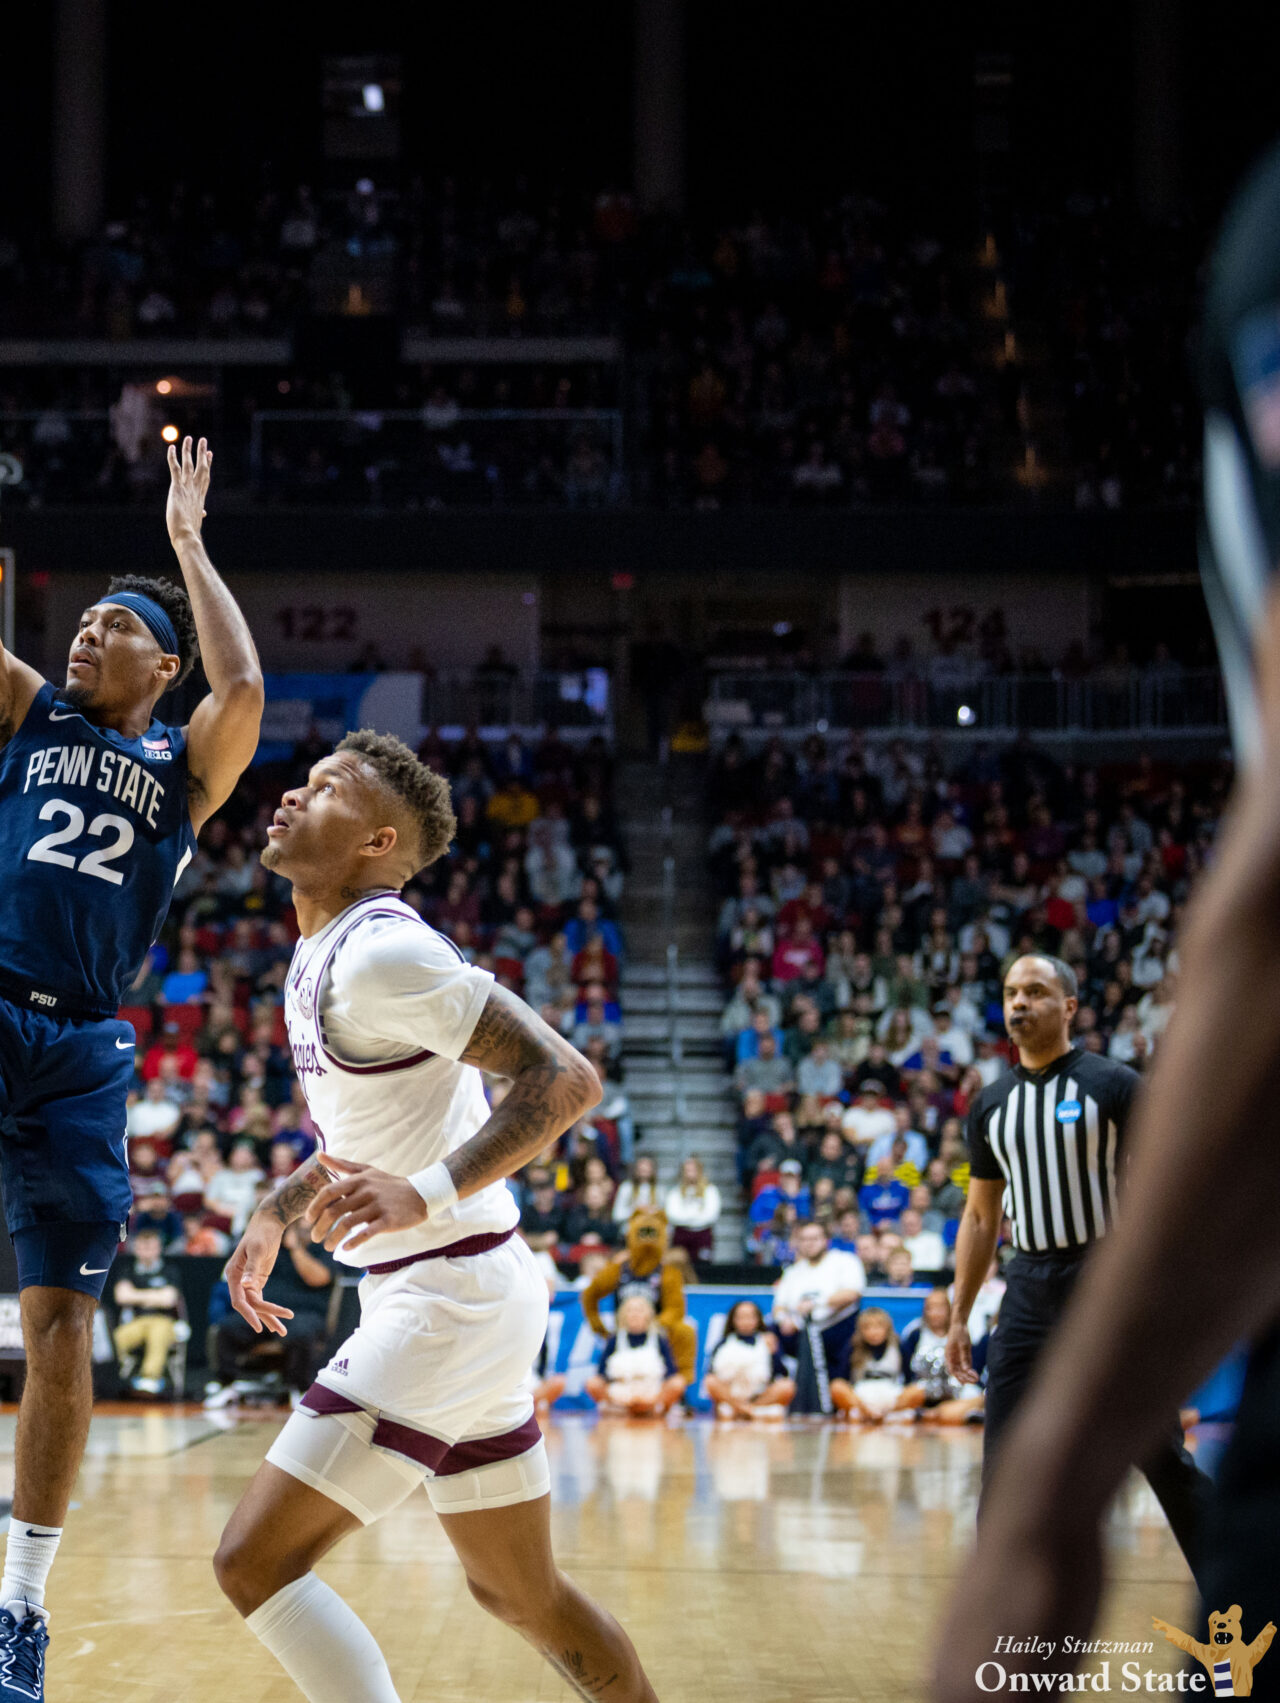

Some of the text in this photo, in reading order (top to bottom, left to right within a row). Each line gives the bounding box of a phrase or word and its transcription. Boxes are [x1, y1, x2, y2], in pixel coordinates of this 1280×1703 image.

[23, 745, 165, 830] PENN STATE
[27, 798, 135, 886] 22
[30, 991, 58, 1007] PSU
